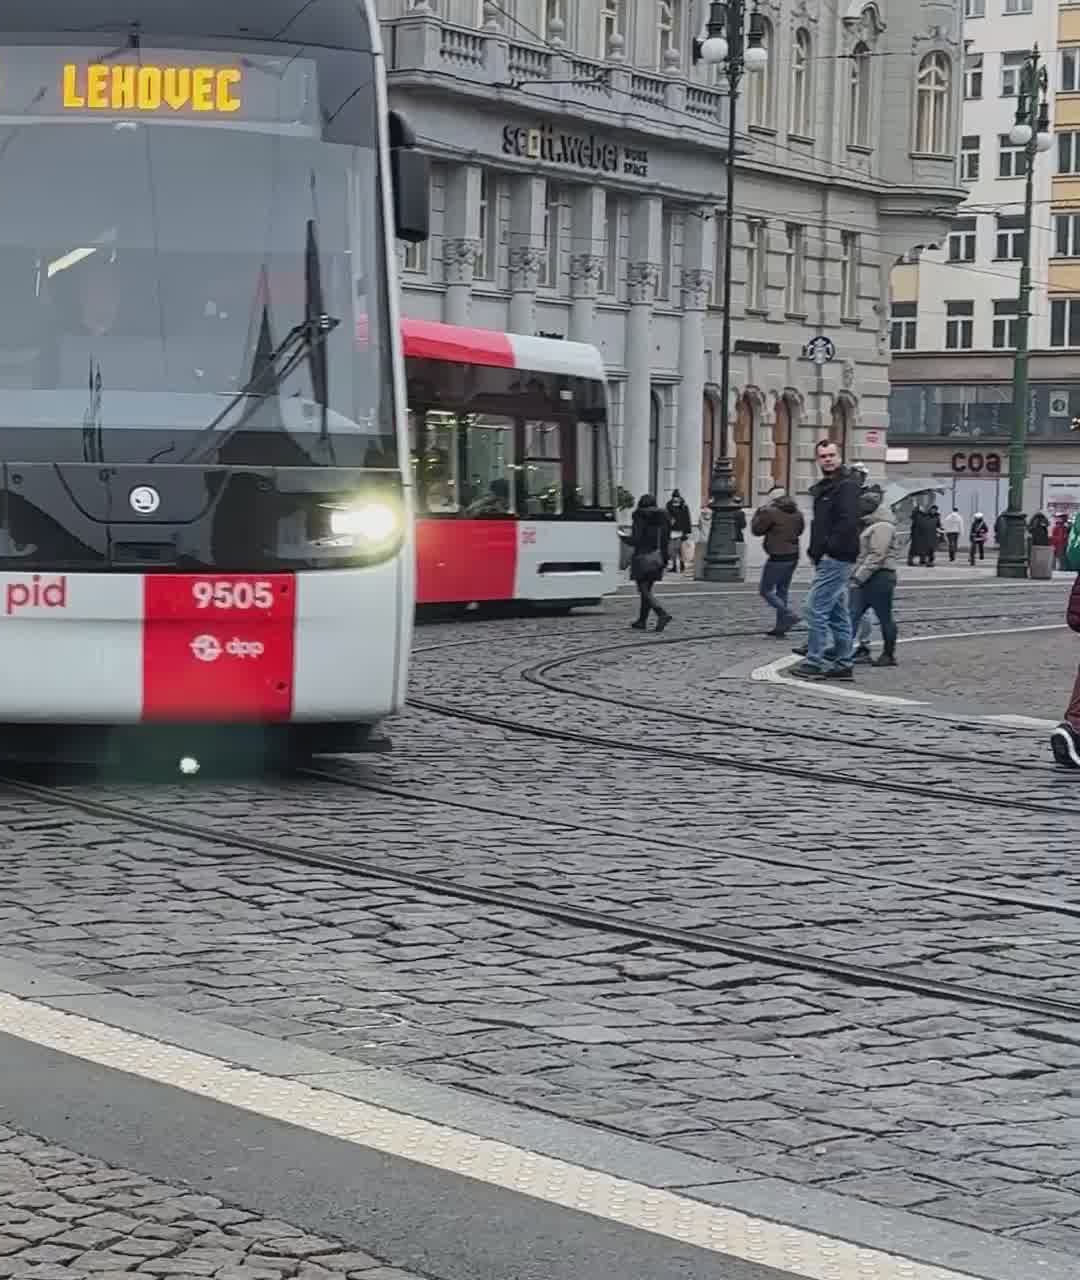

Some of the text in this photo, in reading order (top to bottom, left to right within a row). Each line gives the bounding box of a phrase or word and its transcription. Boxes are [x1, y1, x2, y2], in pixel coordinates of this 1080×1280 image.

[63, 64, 241, 112] LEHOVEC
[951, 452, 1001, 473] coa
[6, 574, 67, 615] pid
[191, 581, 274, 609] 9505
[225, 636, 265, 659] dpp
